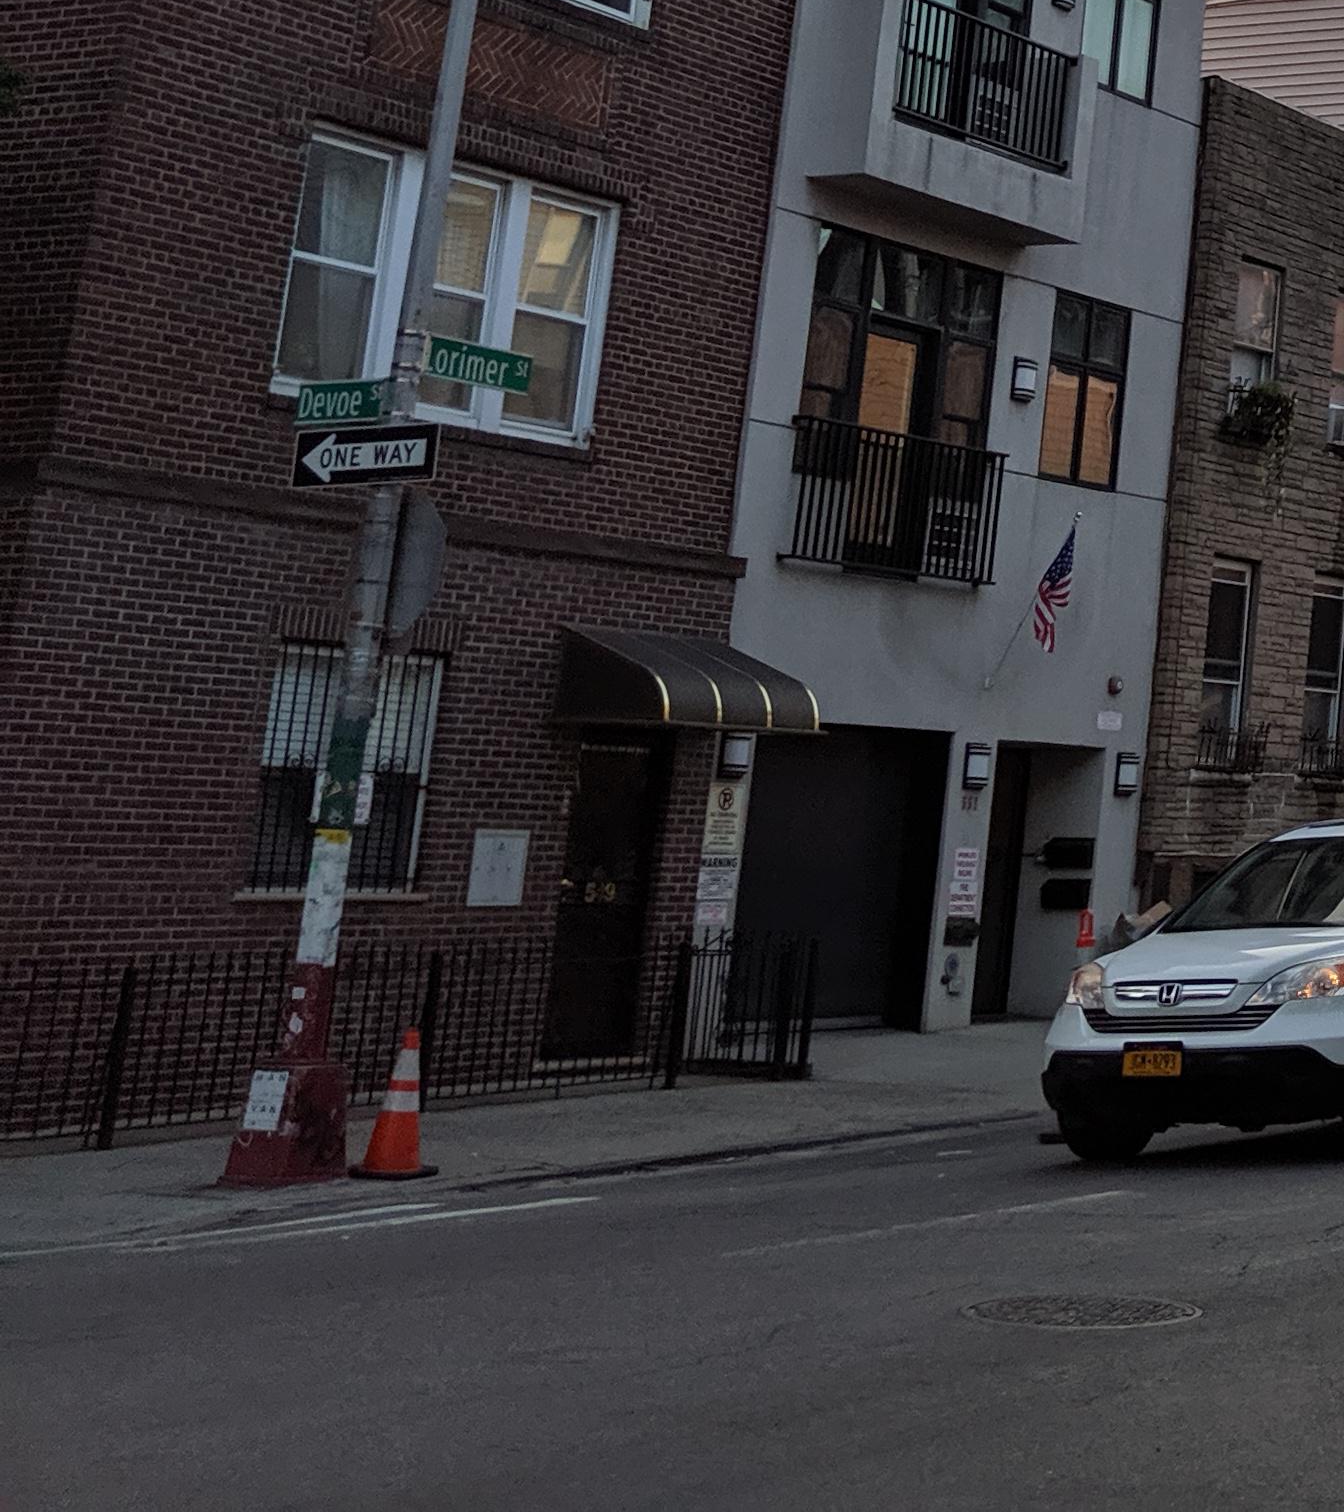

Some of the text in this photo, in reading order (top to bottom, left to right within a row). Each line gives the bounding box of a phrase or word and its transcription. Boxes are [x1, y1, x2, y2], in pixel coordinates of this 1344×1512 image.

[516, 359, 529, 378] St
[300, 388, 363, 418] Devoe
[320, 442, 418, 469] ONE WAY
